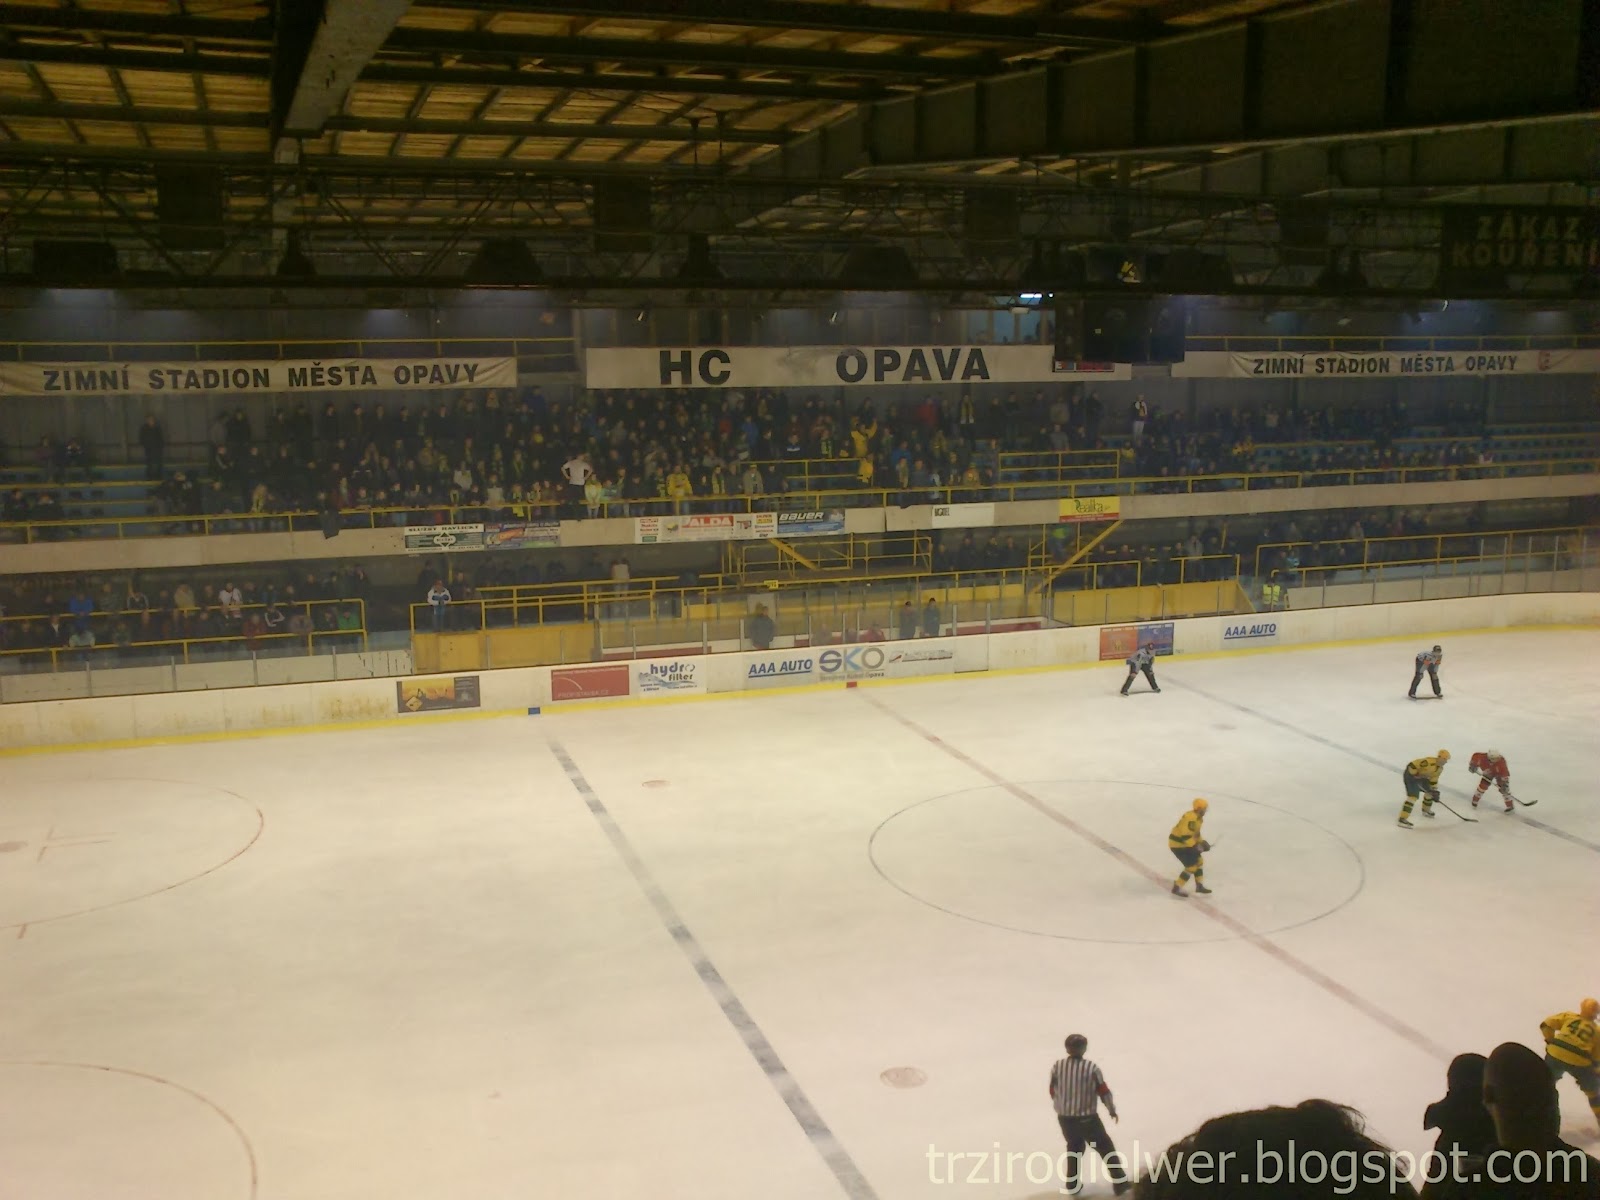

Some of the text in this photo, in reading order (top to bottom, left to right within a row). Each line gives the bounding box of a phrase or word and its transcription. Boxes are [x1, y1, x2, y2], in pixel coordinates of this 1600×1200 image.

[659, 348, 990, 385] HC OPAVA
[1253, 353, 1518, 374] ZIMNÍ STADION MĚSTA OPAVY
[43, 361, 479, 391] ZIMNÍ STADION MĚSTA OPAVY
[1224, 623, 1277, 637] AAA AUTO
[749, 659, 813, 675] AAA AUTO
[819, 647, 885, 673] SKO
[650, 662, 696, 677] hydro
[668, 673, 694, 681] filter
